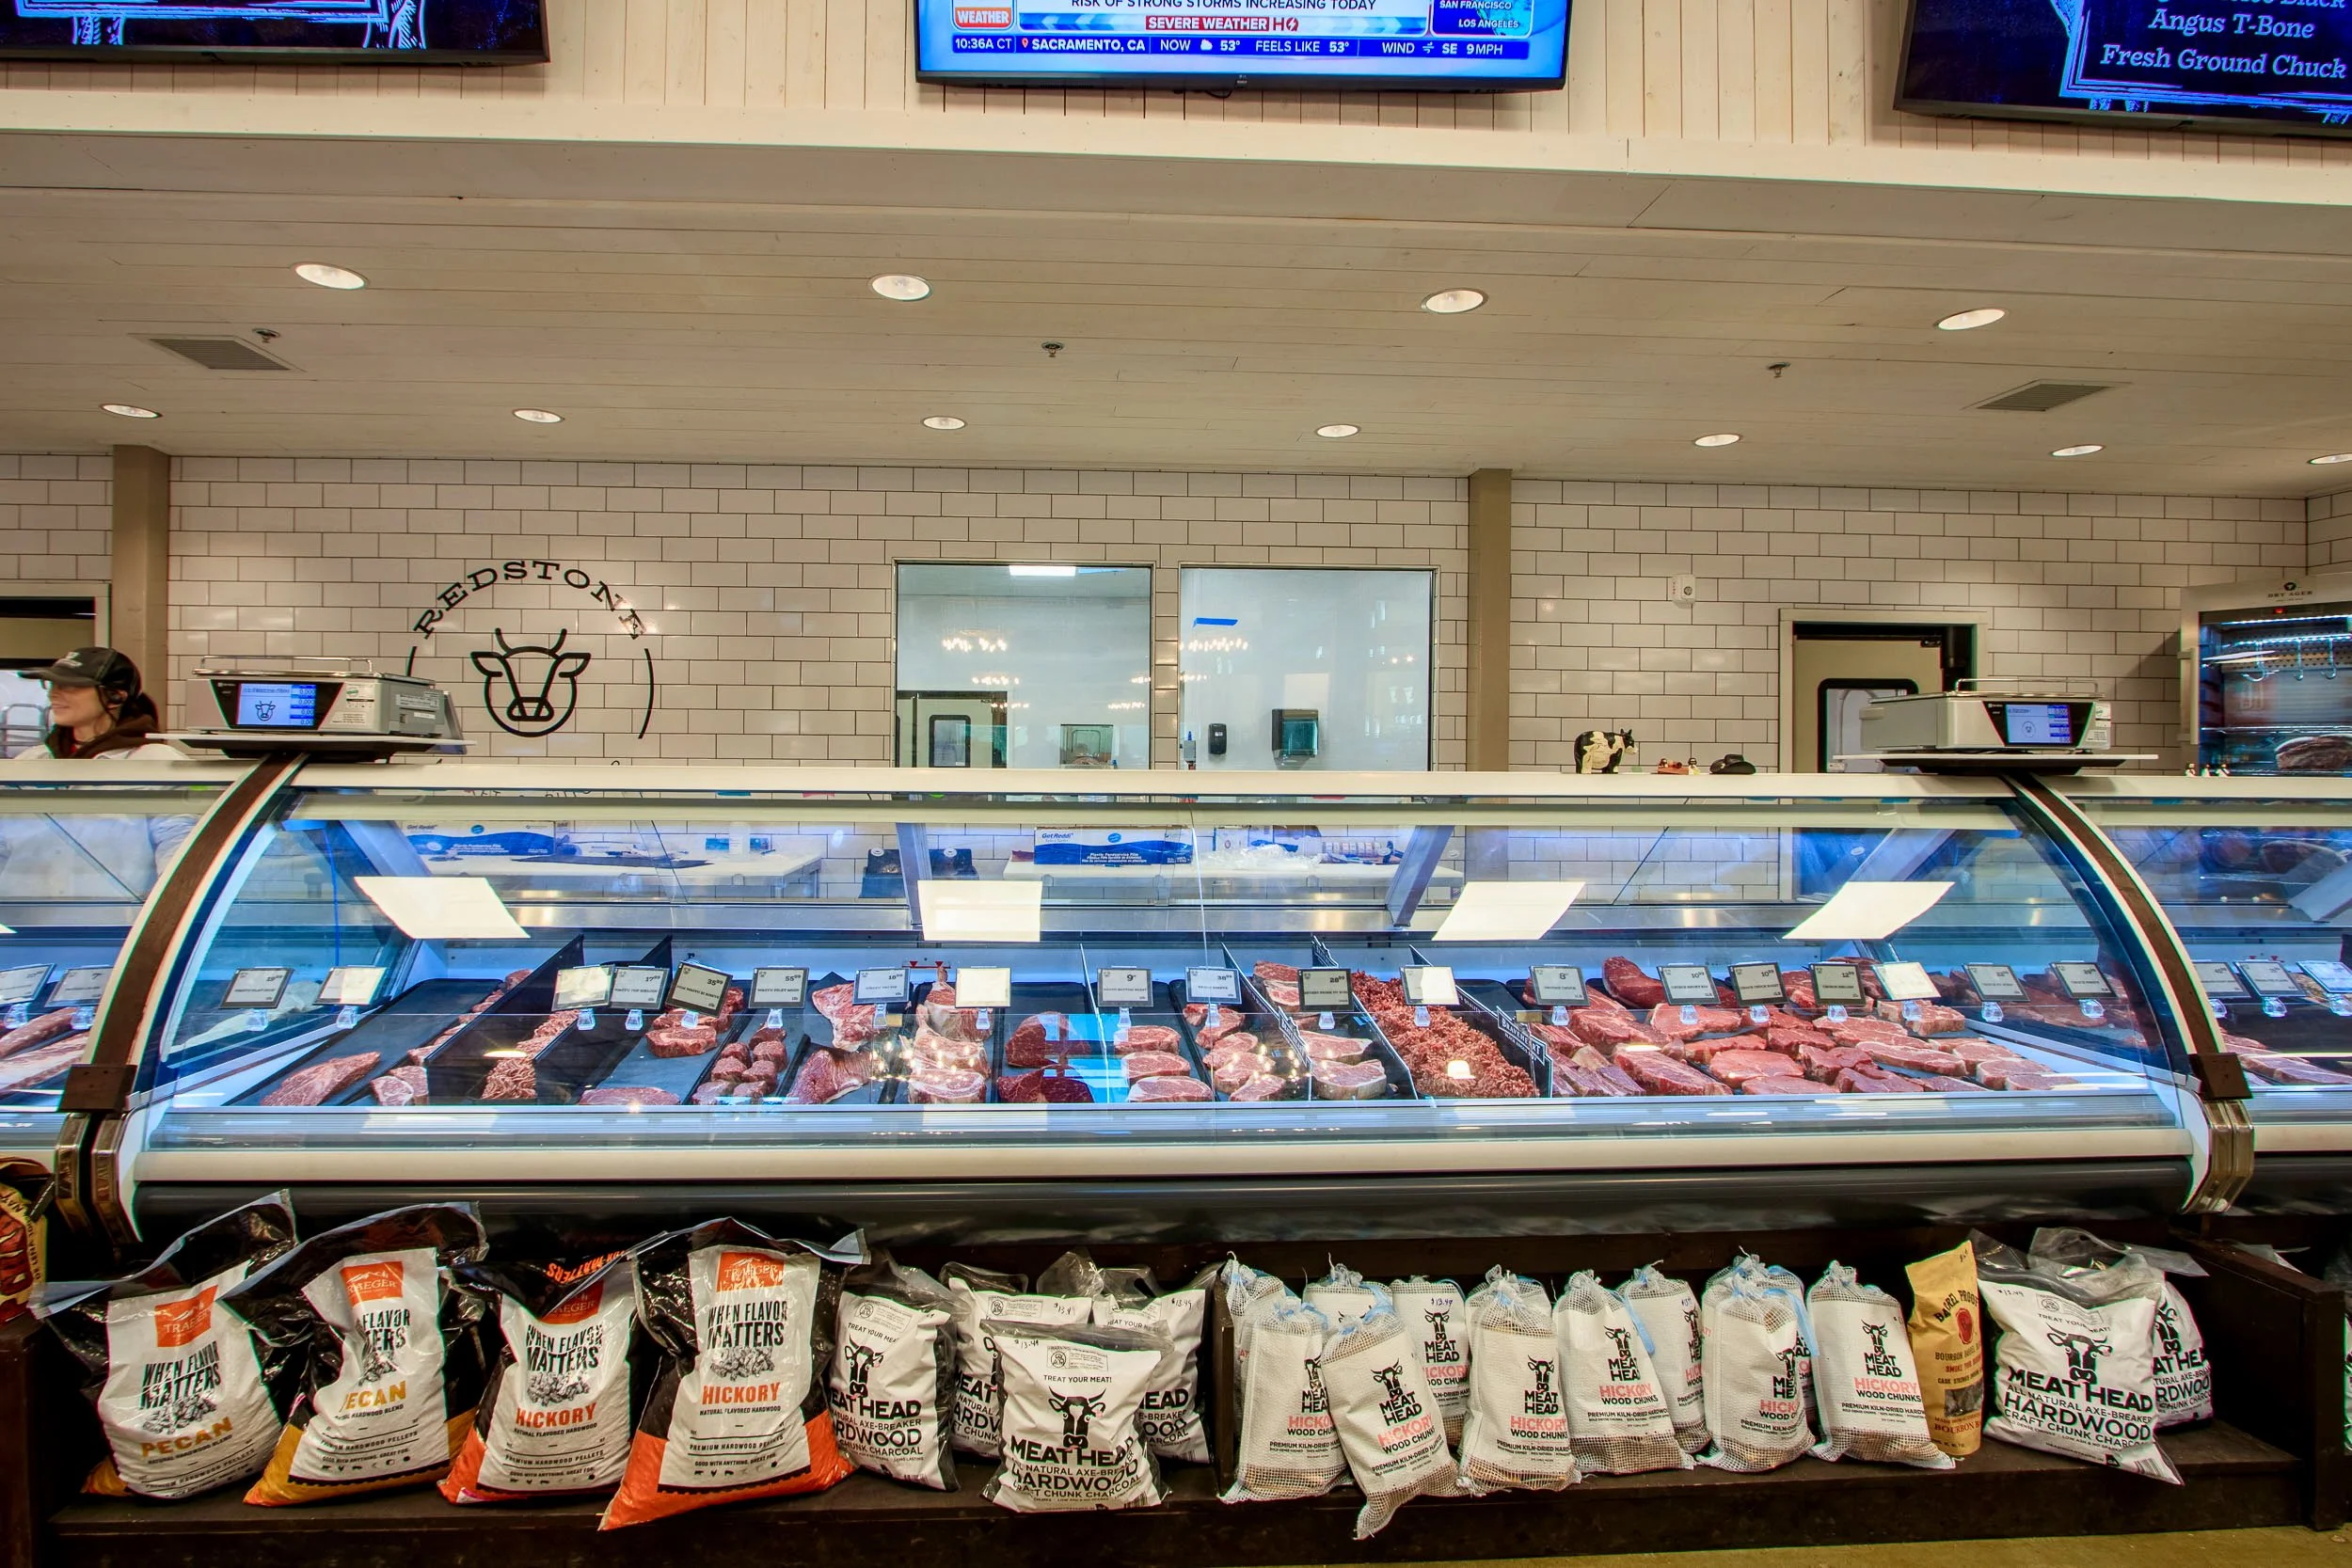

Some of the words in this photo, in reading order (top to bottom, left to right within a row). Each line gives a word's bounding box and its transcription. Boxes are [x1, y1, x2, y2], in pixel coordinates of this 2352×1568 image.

[1258, 0, 1329, 9] INCREASING
[1332, 0, 1377, 10] TODAY
[1439, 1, 1456, 9] SAN
[1460, 1, 1512, 10] FRANCISCO
[957, 10, 1009, 24] WEATHER
[1148, 17, 1200, 30] SEVERE
[1202, 17, 1267, 31] WEATHER
[1458, 19, 1476, 28] LOS
[1477, 19, 1519, 29] ANGELES
[2148, 8, 2227, 37] Angus
[2232, 13, 2316, 39] T-Bone
[955, 38, 994, 50] 10:36A
[996, 39, 1012, 50] CT
[1031, 39, 1124, 52] SACRAMENTO,
[1127, 40, 1146, 52] CA
[1160, 40, 1191, 51] NOW
[1255, 41, 1292, 53] FEELS
[1295, 41, 1321, 54] LIKE
[1382, 42, 1415, 55] WIND
[1441, 43, 1458, 55] SE
[2099, 43, 2171, 69] Fresh
[2177, 48, 2266, 75] Ground
[2272, 55, 2347, 79] Chuck
[362, 1308, 411, 1329] FLAVOR
[708, 1303, 740, 1329] WHEN
[744, 1300, 787, 1322] FLAVOR
[2038, 1312, 2063, 1323] TREAT
[2066, 1319, 2087, 1328] YOUR
[848, 1323, 866, 1334] TREAT
[867, 1328, 883, 1339] YOUR
[1124, 1320, 1143, 1328] YOUR
[526, 1323, 555, 1353] WHEN
[707, 1321, 785, 1351] MATTERS
[1423, 1340, 1457, 1353] MEAT
[142, 1359, 183, 1389] WHEN
[186, 1339, 220, 1375] FLAVOR
[527, 1345, 599, 1374] MATTERS
[1425, 1351, 1460, 1364] HEAD
[1864, 1352, 1897, 1368] MEAT
[1866, 1364, 1902, 1378] HEAD
[138, 1362, 222, 1410] MATTERS
[1043, 1374, 1067, 1384] TREAT
[1853, 1376, 1917, 1394] HICKORY
[340, 1383, 407, 1412] ECAN
[702, 1382, 781, 1405] HICKORY
[1524, 1389, 1559, 1404] MEAT
[1599, 1383, 1653, 1398] HICKORY
[1855, 1389, 1885, 1400] WOOD
[1886, 1392, 1922, 1402] CHUNKS
[958, 1393, 993, 1416] NATURAL
[1378, 1391, 1416, 1415] MEAT
[1601, 1397, 1632, 1405] WOOD
[1633, 1394, 1659, 1405] CHUNKS
[2008, 1384, 2026, 1397] ALL
[2028, 1391, 2080, 1411] NATURAL
[2086, 1405, 2153, 1424] AXE-BREAKER
[751, 1405, 781, 1414] HARDWOOD
[1383, 1402, 1422, 1427] HEAD
[1524, 1402, 1560, 1415] HEAD
[1616, 1410, 1648, 1418] KILN-DRIED
[1759, 1410, 1790, 1420] WOOD
[1841, 1402, 1870, 1411] PREMIUM
[1870, 1404, 1905, 1414] KILN-DRIED
[516, 1402, 597, 1429] HICKORY
[2004, 1391, 2152, 1441] HARDWOOD
[859, 1418, 922, 1431] AXE-BREAKER
[1510, 1415, 1567, 1432] HICKORY
[1740, 1418, 1772, 1431] PREMIUM
[1934, 1421, 1975, 1434] BOURBON
[2004, 1408, 2044, 1427] CRAFT
[2047, 1422, 2092, 1440] CHUNK
[139, 1416, 233, 1458] PECAN
[1287, 1428, 1316, 1436] WOOD
[1510, 1428, 1539, 1439] WOOD
[1540, 1431, 1568, 1440] CHUNKS
[1382, 1438, 1411, 1455] WOOD
[1411, 1425, 1436, 1444] CHUNKS
[1496, 1438, 1522, 1450] PREMIUM
[1522, 1444, 1554, 1452] KILN-DRIED
[575, 1449, 604, 1462] PELLETS
[869, 1447, 924, 1457] CHARCOAL
[1372, 1459, 1400, 1472] PREMIUM
[1400, 1447, 1429, 1465] KILN-DRIED
[1025, 1465, 1073, 1476] NATURAL
[1043, 1489, 1083, 1498] CHUNK
[1085, 1474, 1140, 1498] CHARCOAL
